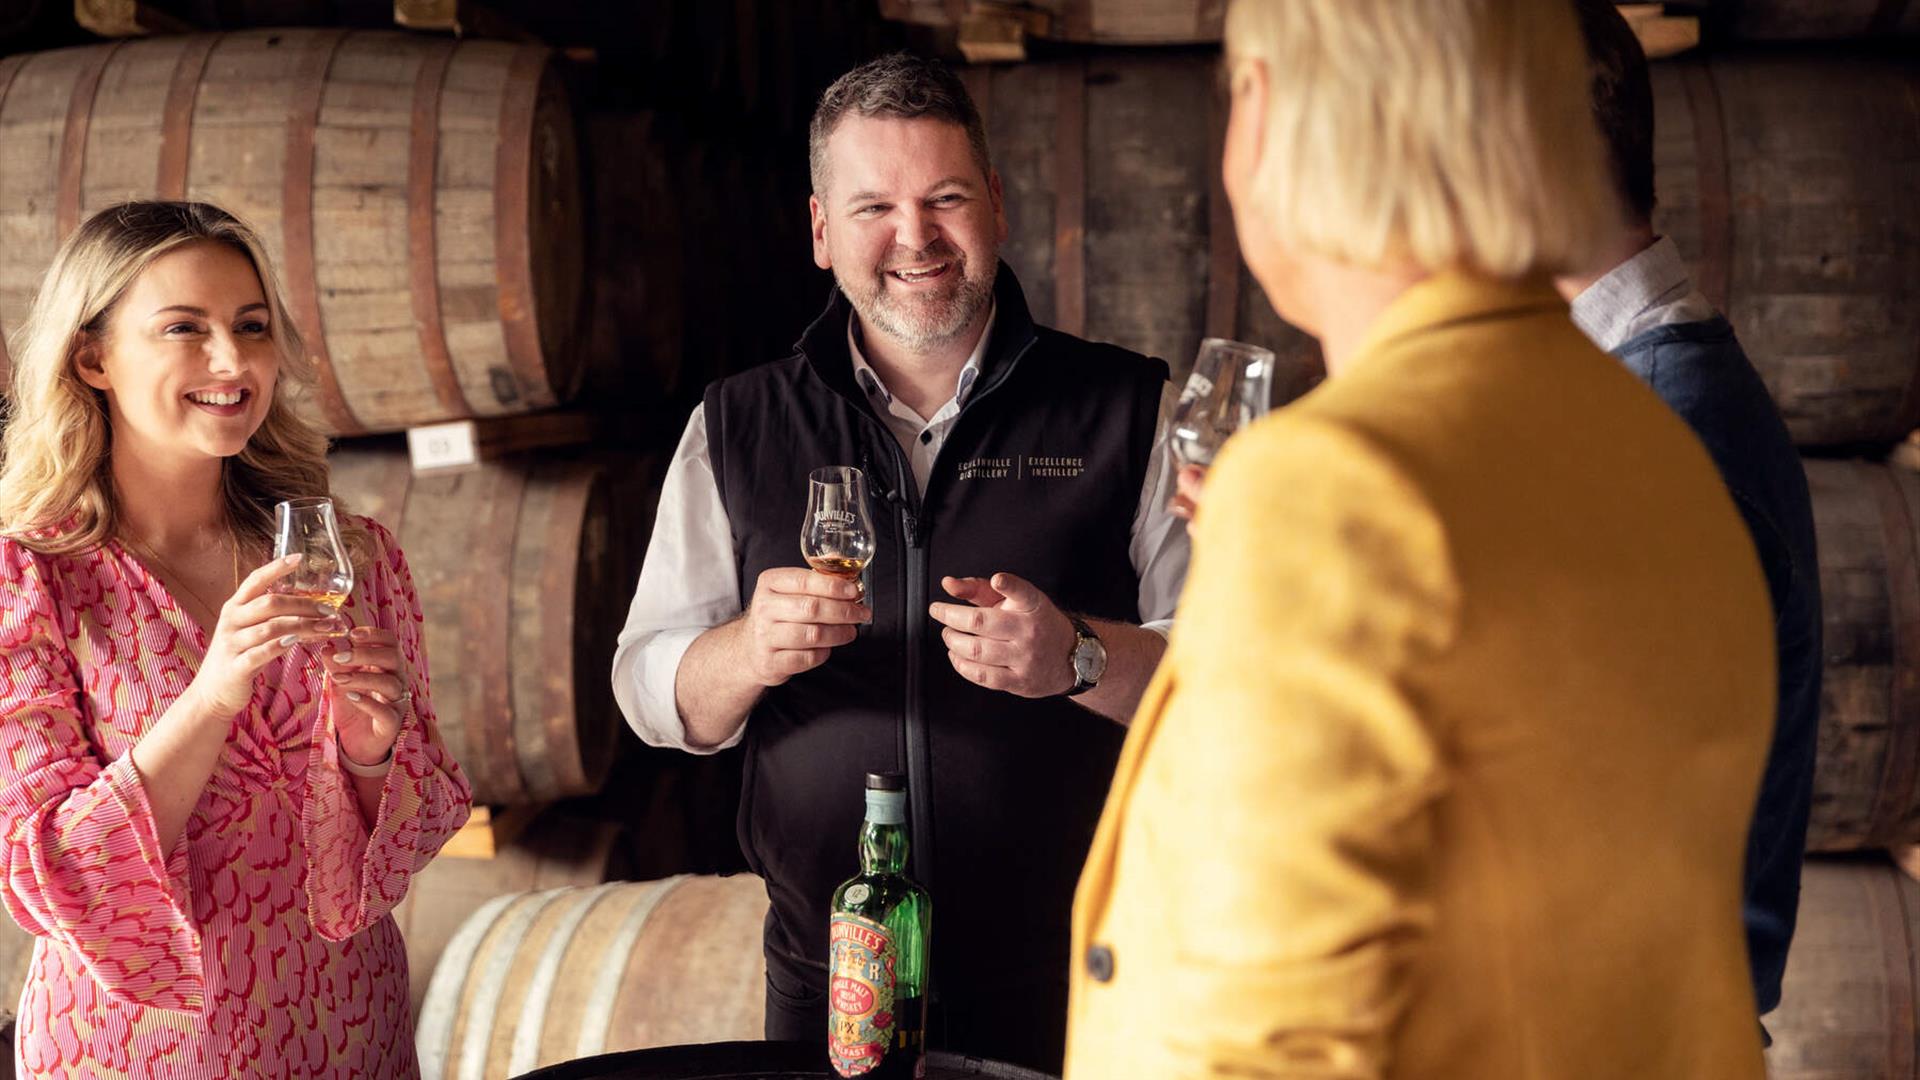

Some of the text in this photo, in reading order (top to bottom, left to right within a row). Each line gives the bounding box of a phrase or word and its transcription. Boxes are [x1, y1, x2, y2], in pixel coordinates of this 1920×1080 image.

[1028, 457, 1082, 467] EXCELLENCE
[959, 469, 1009, 480] DISTILLERY
[850, 982, 870, 998] MALT
